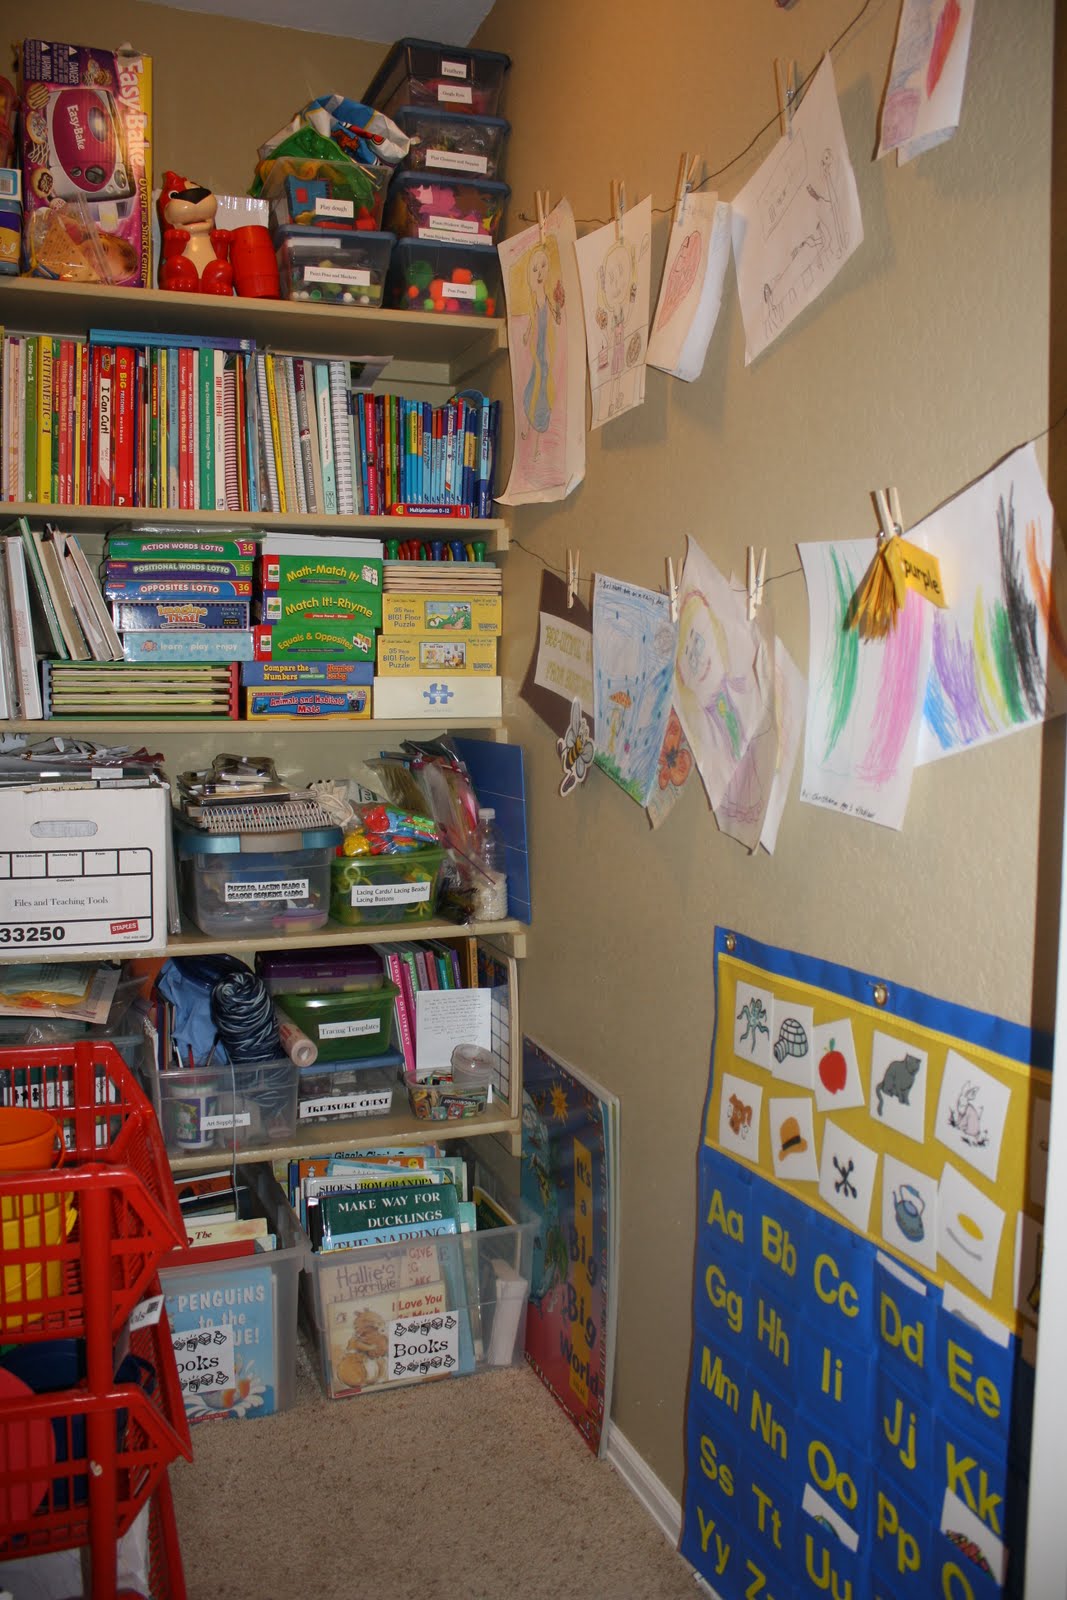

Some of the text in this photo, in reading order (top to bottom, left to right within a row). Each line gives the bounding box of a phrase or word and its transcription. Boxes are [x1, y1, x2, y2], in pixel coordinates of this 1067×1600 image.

[118, 59, 148, 167] Easy-Bake
[67, 104, 85, 151] Easy-Bake
[139, 178, 147, 209] Oven
[320, 204, 330, 212] Play
[141, 225, 149, 250] Snack
[42, 347, 51, 420] ARITHMETIC
[101, 395, 109, 413] Can
[101, 415, 109, 434] Cut!
[307, 461, 316, 496] Curriculum
[141, 543, 170, 551] ACTION
[200, 544, 224, 552] LOTTO
[133, 563, 177, 573] POSITIONAL
[206, 565, 230, 574] LOTTO
[286, 565, 347, 582] Math-Match
[349, 571, 359, 582] It!
[903, 556, 941, 594] purple
[140, 584, 219, 593] OPPOSITES LOTTO
[238, 583, 249, 591] 36
[157, 604, 207, 617] Imagine
[285, 597, 373, 617] Match It!-Rhyme
[167, 612, 198, 623] That!
[190, 643, 208, 651] play
[215, 643, 237, 651] enjoy
[277, 632, 304, 651] Equals
[315, 632, 353, 650] Opposites
[263, 664, 309, 674] Compare the
[263, 673, 298, 681] Numbers
[270, 696, 345, 707] Animals and Habitats
[297, 705, 320, 714] Mats
[227, 884, 257, 892] PUZZLES,
[356, 888, 374, 896] Lacing
[14, 896, 108, 908] Files and Teaching Tools
[356, 896, 373, 904] Lacing
[112, 923, 137, 932] STAPLES
[347, 1024, 379, 1033] Templates
[399, 1001, 410, 1046] ON LITERACY
[306, 1098, 389, 1113] TREASURE CHEST
[575, 1158, 591, 1189] It's
[319, 1178, 434, 1193] SHOES FROM GRANDPA
[338, 1192, 441, 1213] MAKE WAY FOR
[580, 1202, 586, 1216] a
[368, 1210, 443, 1228] DUCKLINGS
[195, 1230, 213, 1240] The
[409, 1247, 432, 1259] GIVE
[569, 1226, 597, 1286] Big
[336, 1264, 395, 1288] Hallie's
[349, 1279, 396, 1299] Horrible
[392, 1294, 442, 1312] I Love You
[707, 1188, 1001, 1419] Aa Bb Cc Dd Ee
[198, 1309, 246, 1329] to the
[567, 1281, 597, 1349] Big
[393, 1339, 449, 1359] Books
[176, 1355, 219, 1374] ooks
[560, 1331, 603, 1399] World
[705, 1264, 1003, 1533] Gg Hh Ii Jj Kk
[700, 1344, 921, 1574] Mm Nn Oo Pp
[700, 1434, 852, 1600] Ss Tt Uu
[697, 1506, 731, 1575] Yy
